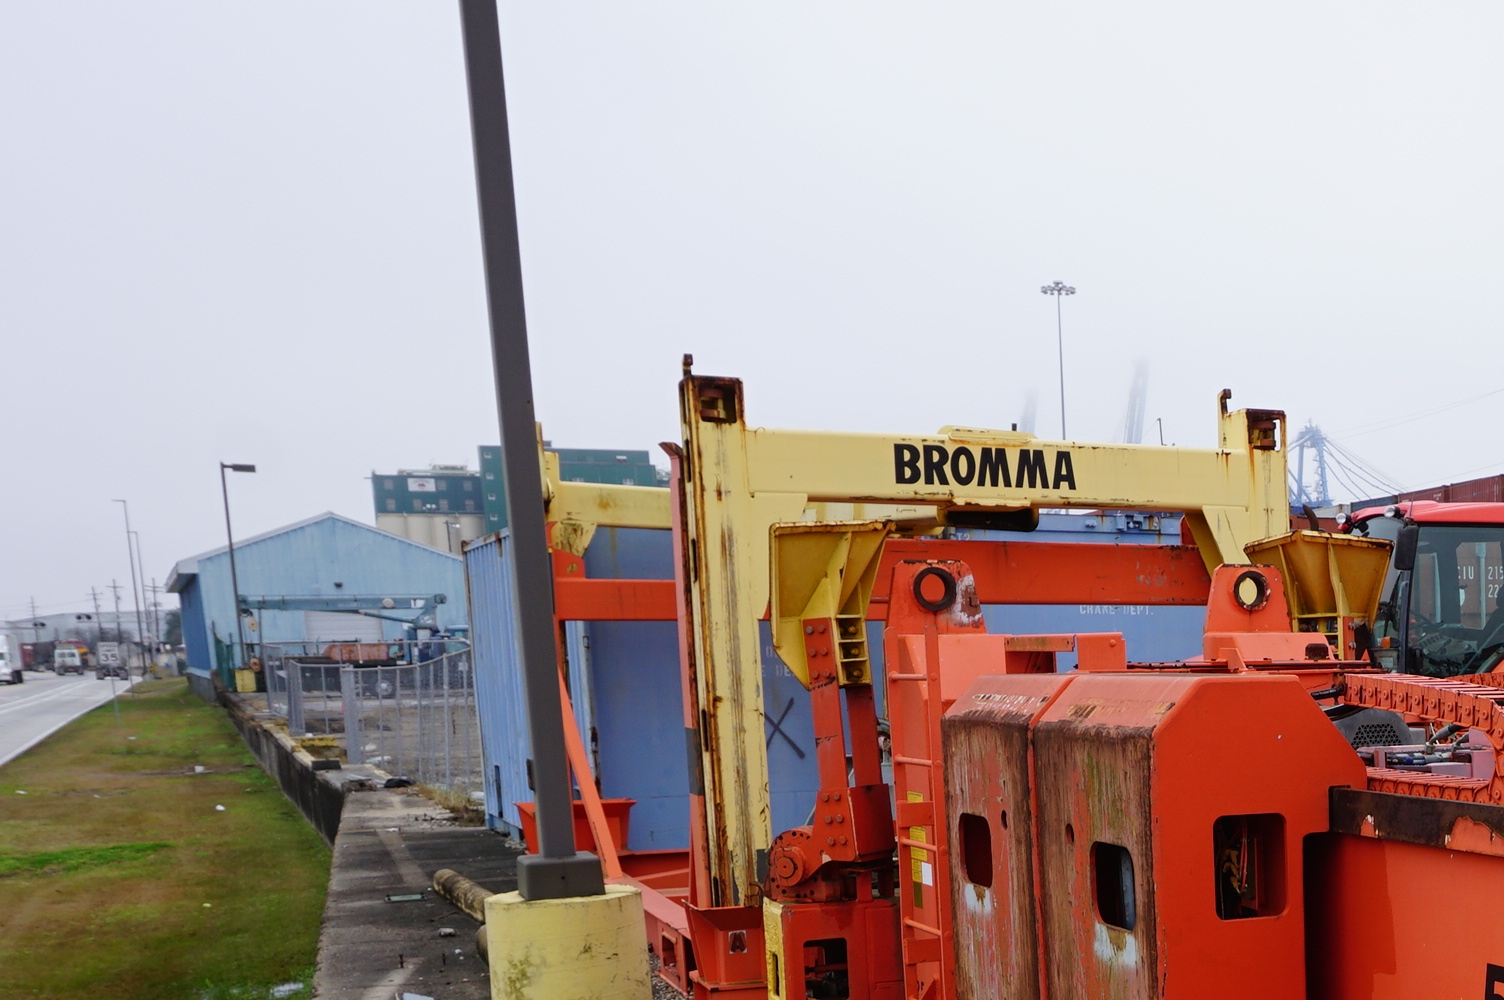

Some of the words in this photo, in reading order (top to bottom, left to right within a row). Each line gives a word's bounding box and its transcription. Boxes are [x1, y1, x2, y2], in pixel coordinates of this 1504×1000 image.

[893, 443, 1077, 490] BROMMA
[1488, 584, 1503, 598] 22
[1079, 604, 1115, 615] CRANE
[101, 653, 118, 662] 35
